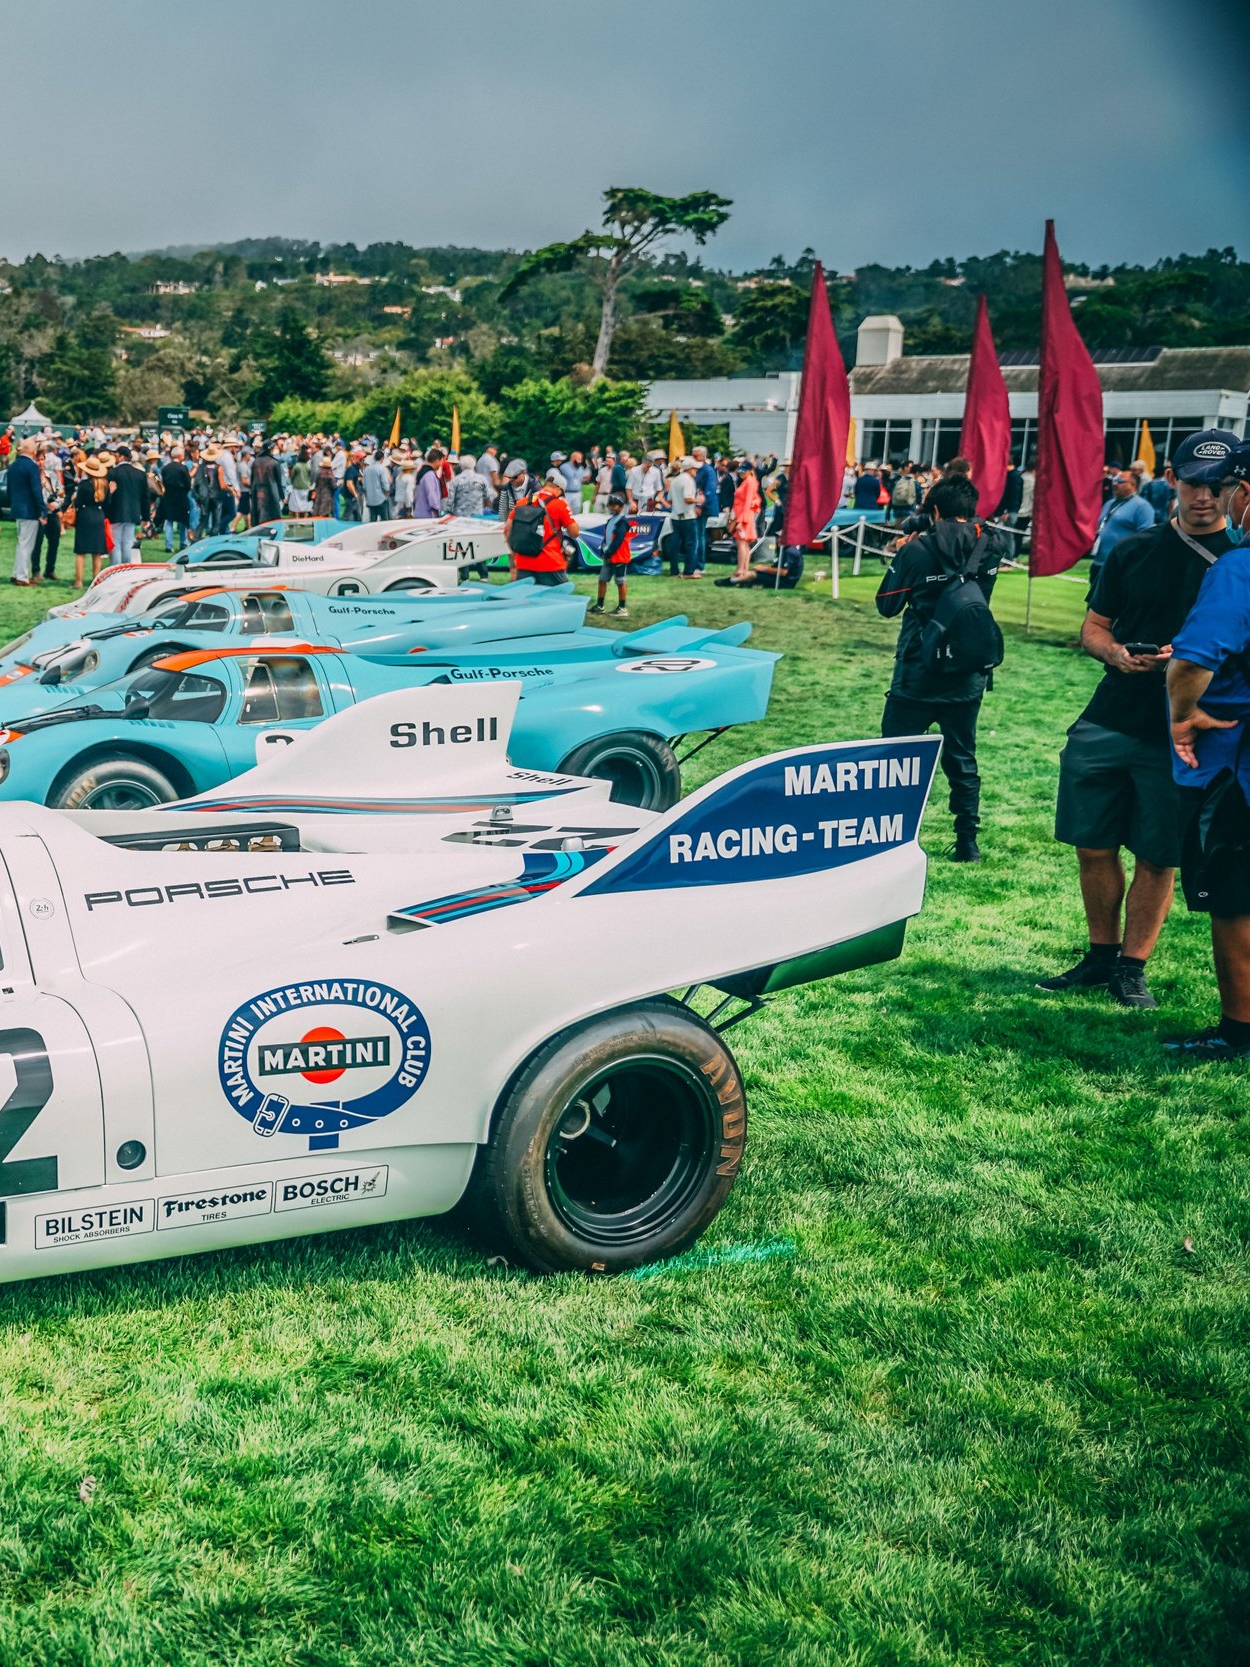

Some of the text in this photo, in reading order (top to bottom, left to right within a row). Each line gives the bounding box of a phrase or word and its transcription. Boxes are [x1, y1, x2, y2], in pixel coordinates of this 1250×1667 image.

[328, 606, 396, 615] Gulf-Porsche
[450, 667, 554, 680] Gulf-Porsche
[389, 717, 498, 748] Shell
[507, 771, 573, 786] Shell
[784, 757, 921, 796] MARTINI
[84, 869, 356, 911] PORSCHE
[223, 982, 426, 1107] MARTINI INTERNATIONAL CLUB
[263, 1041, 385, 1072] MARTINI
[283, 1175, 359, 1201] BOSCH
[310, 1193, 350, 1205] ELECTRIC
[163, 1187, 267, 1218] Firestone
[201, 1211, 227, 1221] TIRES
[45, 1206, 144, 1237] BILSTEIN
[53, 1226, 130, 1244] SHOCK ABSORBERS
